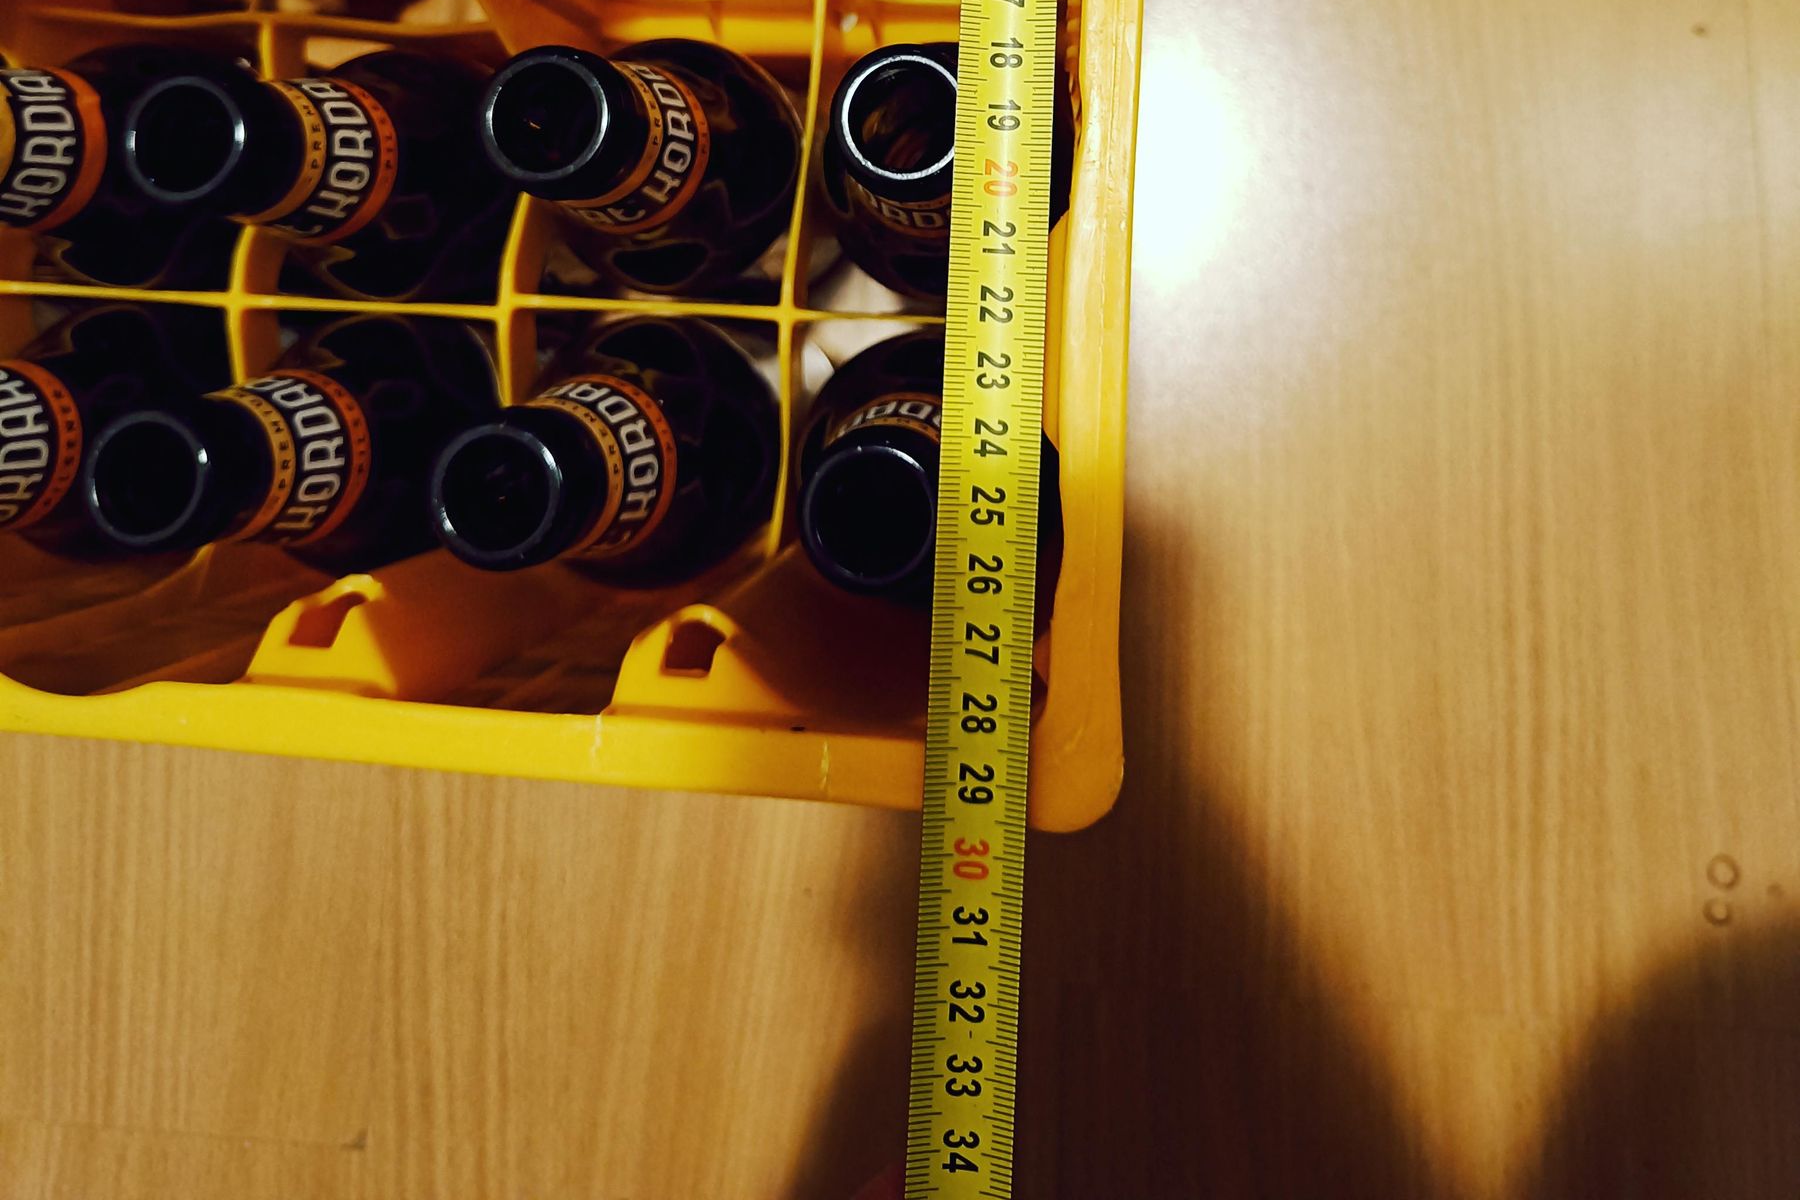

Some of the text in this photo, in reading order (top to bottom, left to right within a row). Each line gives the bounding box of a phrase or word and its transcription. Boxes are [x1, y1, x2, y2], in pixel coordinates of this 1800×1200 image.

[989, 37, 1024, 69] 18
[986, 99, 1021, 132] 19
[983, 158, 1019, 198] 20
[982, 219, 1017, 256] 21
[978, 284, 1014, 323] 22
[976, 351, 1012, 390] 23
[973, 417, 1009, 458] 24
[969, 484, 1006, 526] 25
[966, 553, 1004, 595] 26
[964, 621, 1001, 666] 27
[960, 691, 998, 735] 28
[957, 762, 995, 806] 29
[952, 837, 991, 882] 30
[951, 904, 990, 948] 31
[948, 978, 987, 1025] 32
[944, 1052, 984, 1099] 33
[941, 1128, 981, 1175] 34
